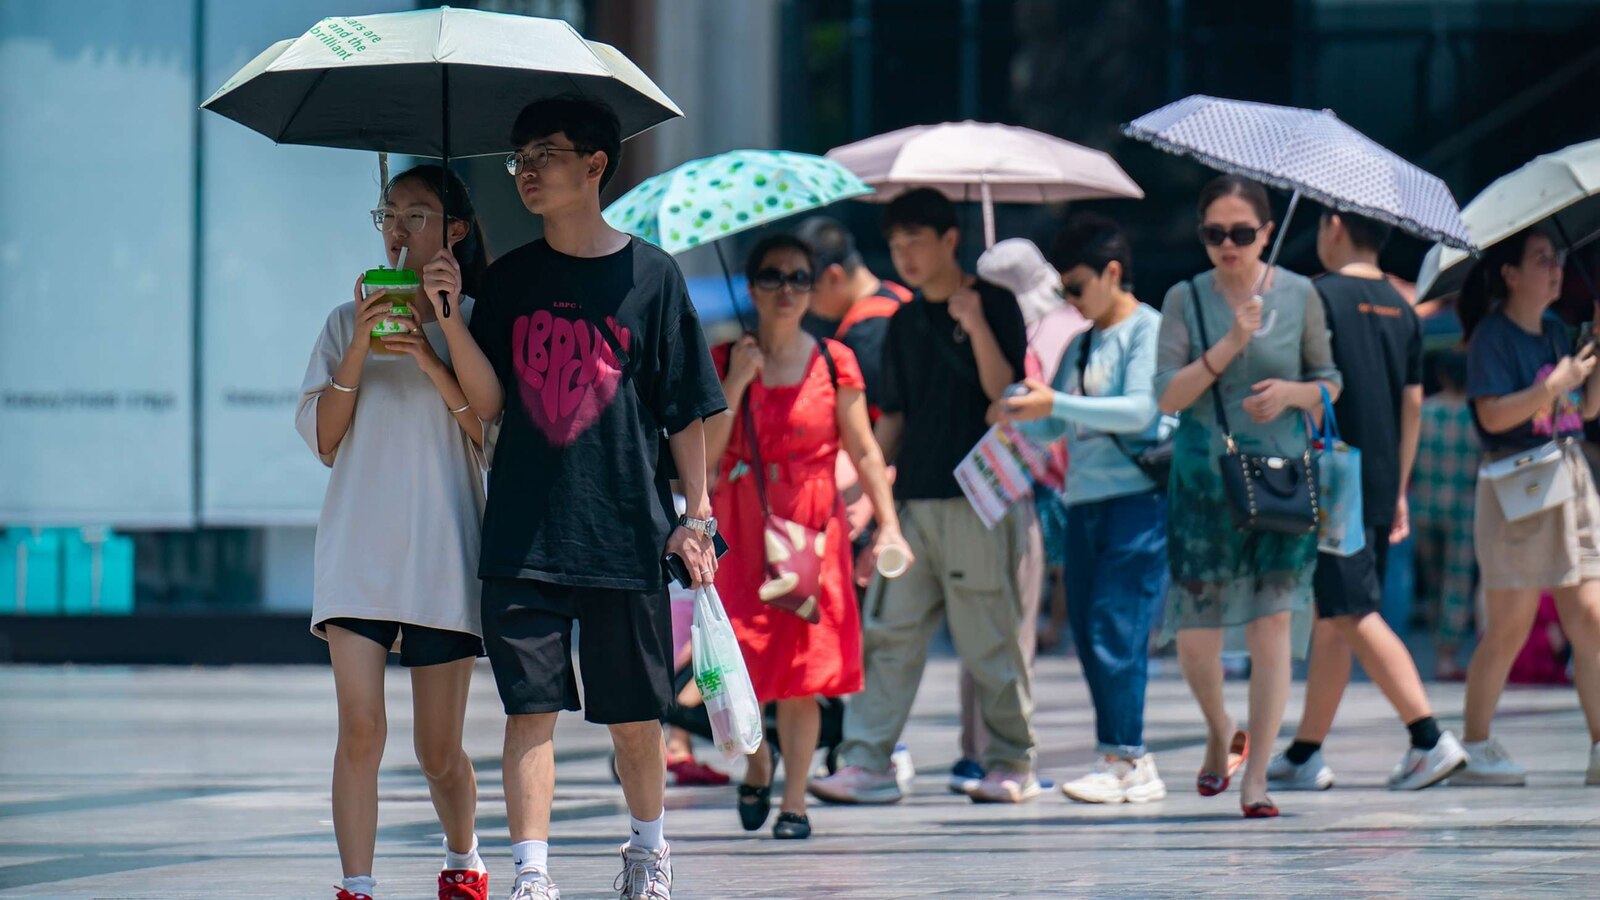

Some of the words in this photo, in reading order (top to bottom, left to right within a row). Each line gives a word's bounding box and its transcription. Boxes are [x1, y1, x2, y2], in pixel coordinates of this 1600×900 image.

[310, 26, 353, 61] brilliant
[328, 23, 353, 38] and
[348, 37, 367, 52] the
[363, 30, 382, 43] are
